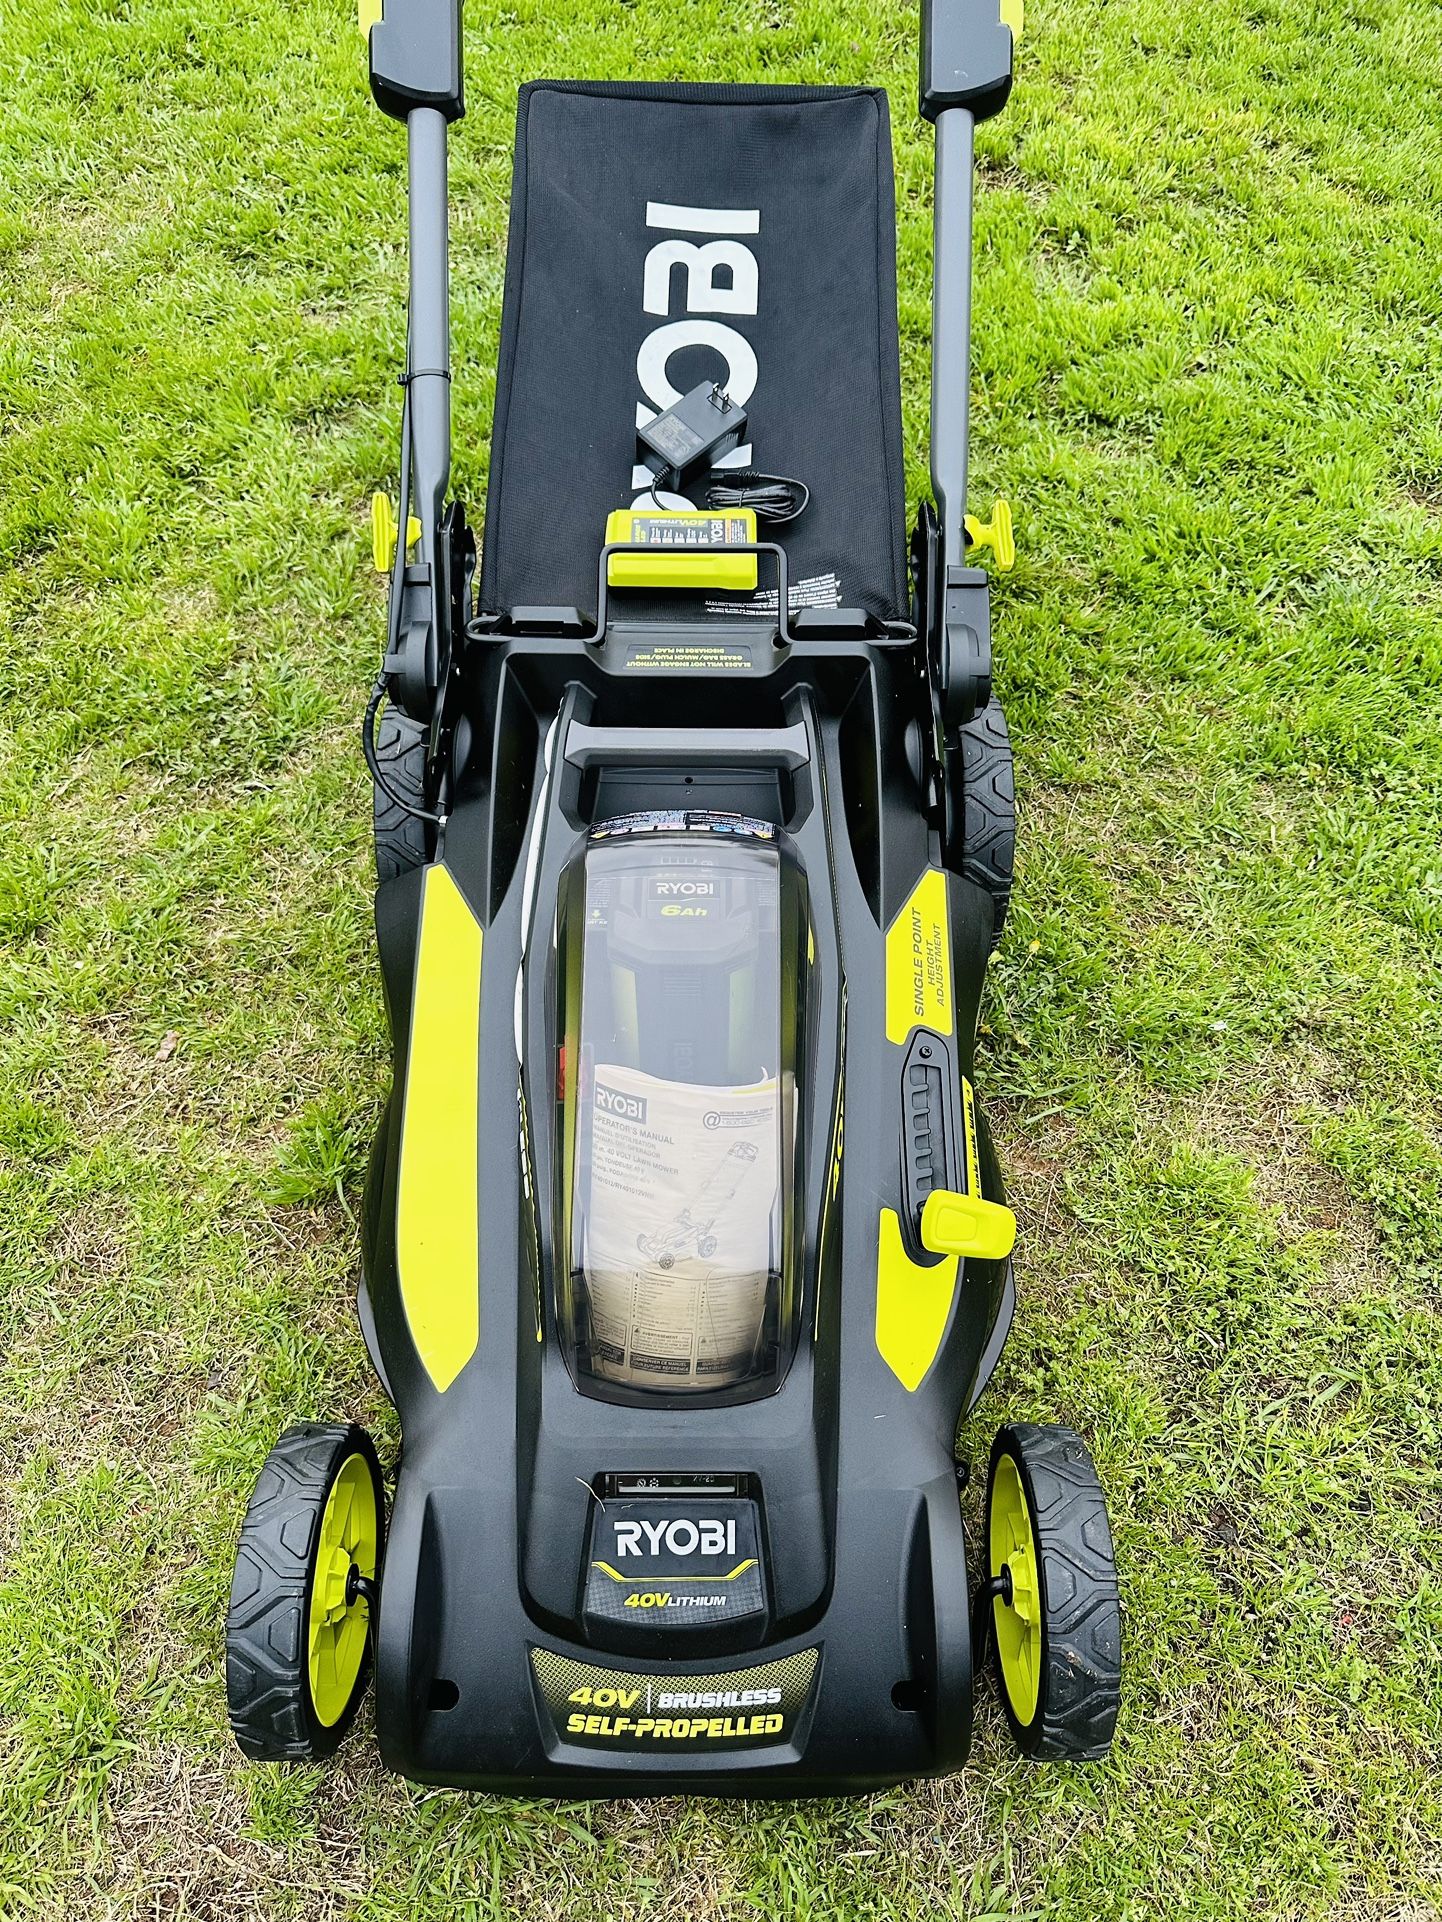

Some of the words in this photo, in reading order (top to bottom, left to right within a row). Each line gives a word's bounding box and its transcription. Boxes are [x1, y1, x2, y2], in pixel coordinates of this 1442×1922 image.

[630, 202, 760, 510] OBI
[710, 519, 723, 544] YOBI
[656, 882, 714, 895] RYOBI
[660, 904, 708, 917] 6Ah
[912, 906, 923, 955] POINT
[926, 939, 936, 986] HEIGHT
[933, 923, 945, 1007] ADJUSTMENT
[913, 957, 924, 1017] SINGLE
[596, 1087, 643, 1119] RYOBI
[639, 1129, 675, 1145] MANUAL
[616, 1150, 631, 1161] VOLT
[652, 1161, 679, 1176] MOWER
[613, 1519, 736, 1557] RYOBI
[567, 1687, 641, 1709] 40V
[657, 1687, 783, 1709] BRUSHLESS
[566, 1713, 784, 1738] SELF-PROPELLED
